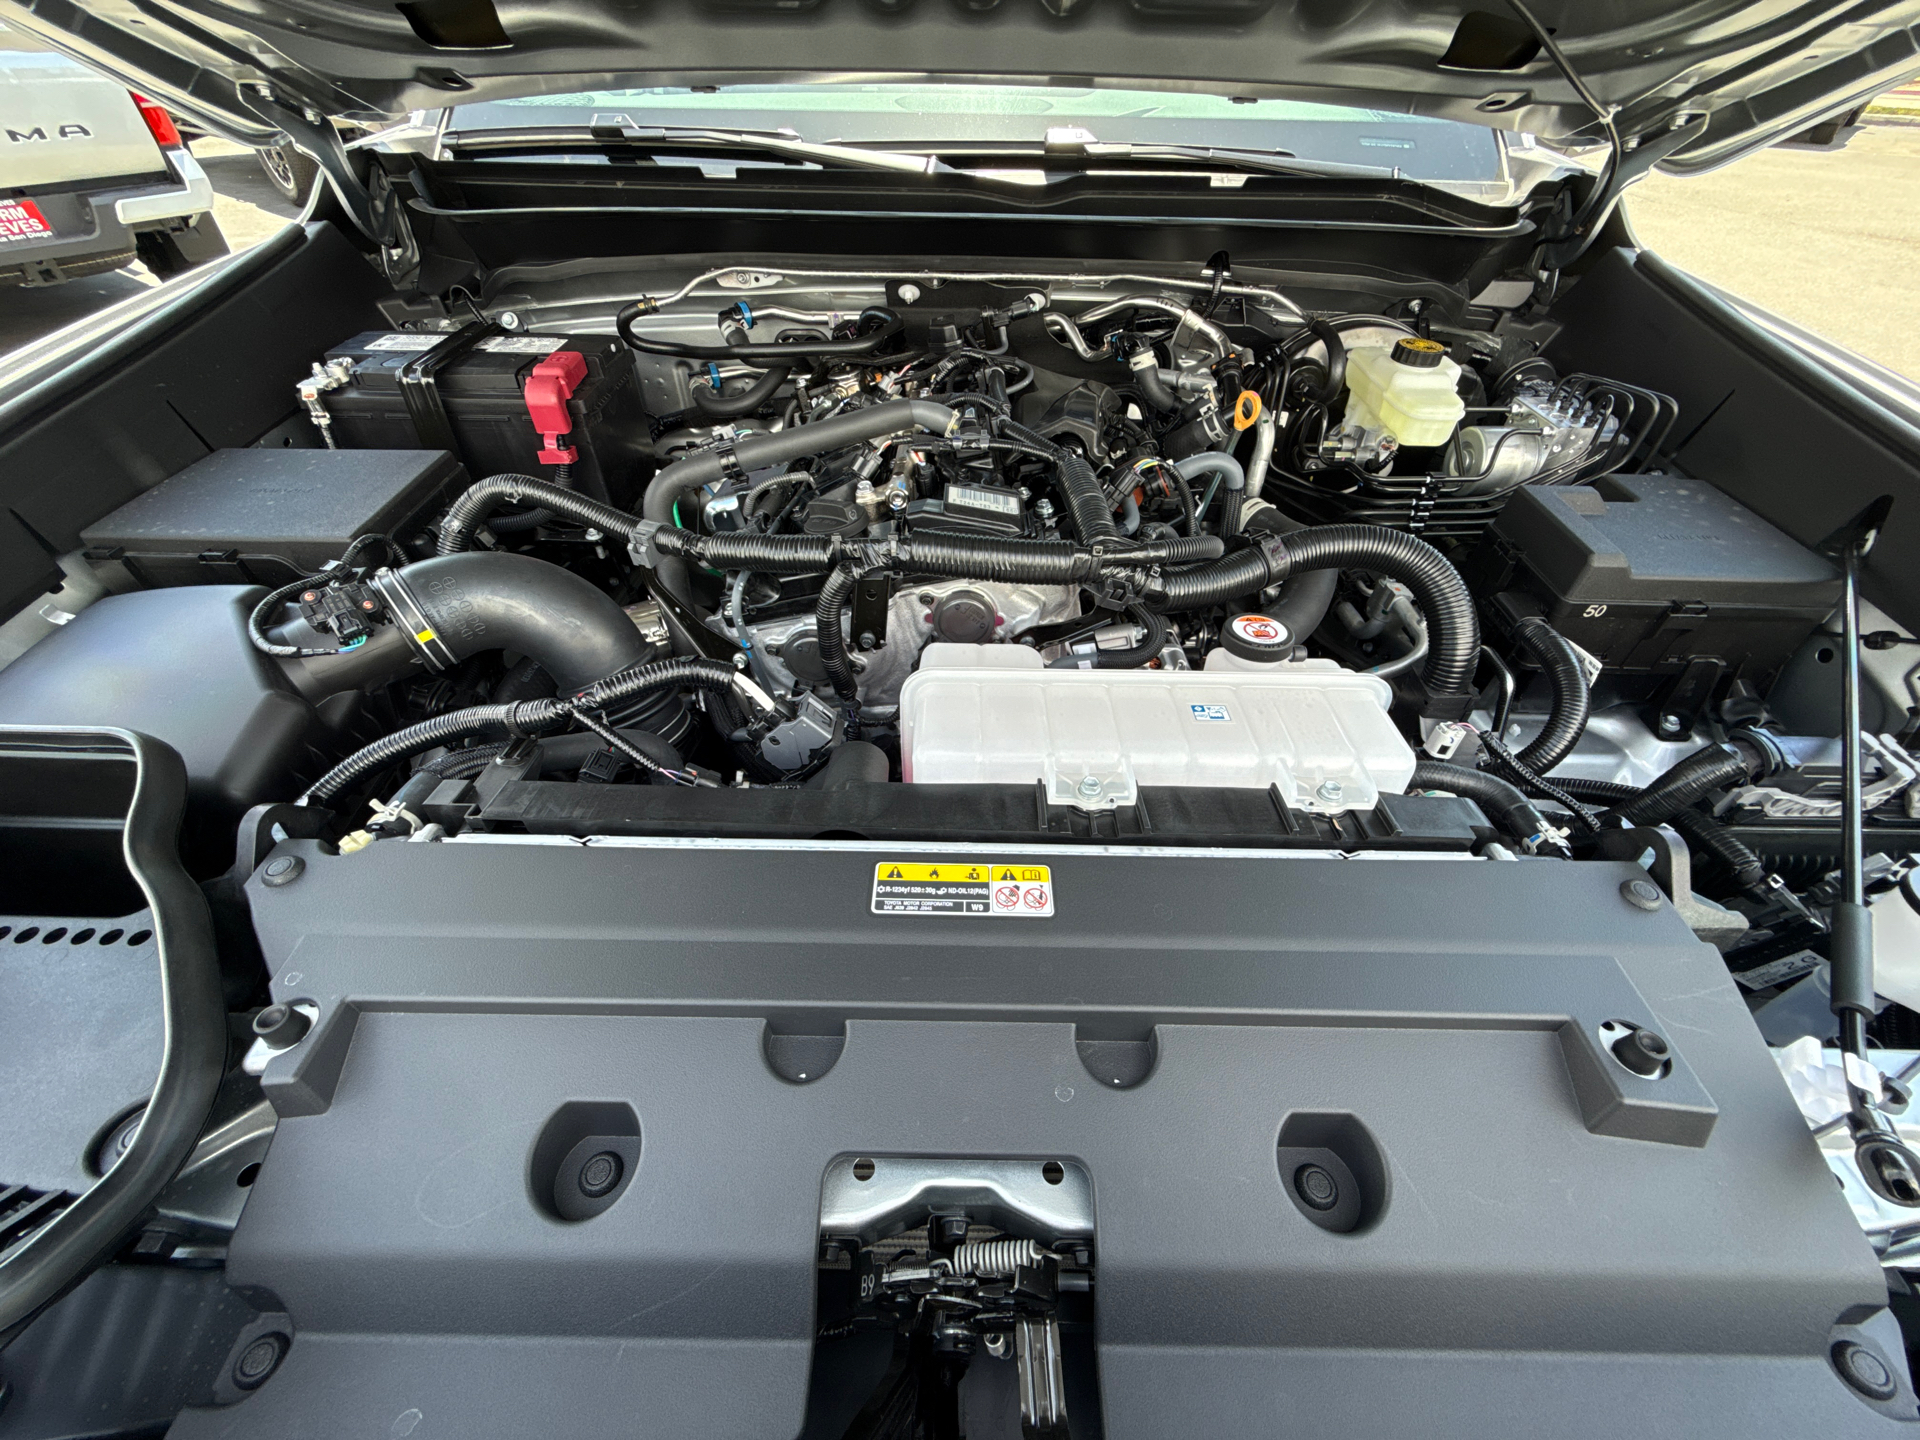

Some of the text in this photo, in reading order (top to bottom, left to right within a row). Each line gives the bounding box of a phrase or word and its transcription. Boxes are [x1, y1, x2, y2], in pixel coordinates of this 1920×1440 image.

[26, 230, 53, 239] Diego
[1583, 605, 1607, 617] 50
[885, 886, 910, 895] R-1234yf
[947, 886, 989, 896] ND-OIL12(PAG)
[971, 903, 984, 911] W9
[861, 1274, 875, 1297] B9
